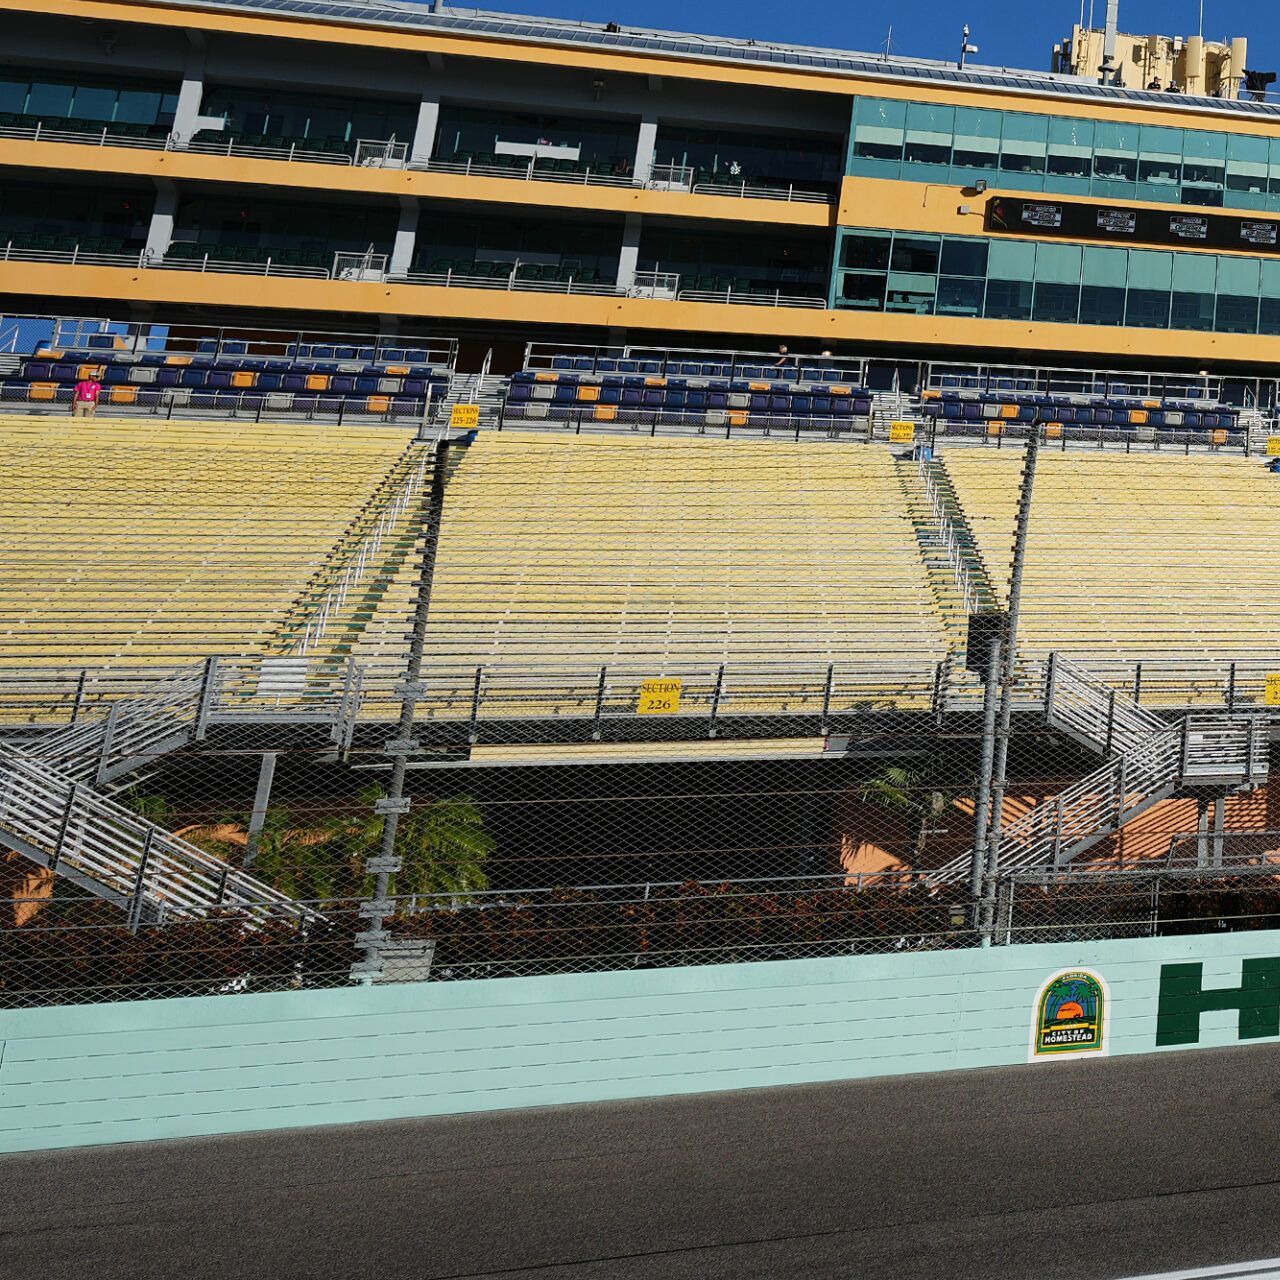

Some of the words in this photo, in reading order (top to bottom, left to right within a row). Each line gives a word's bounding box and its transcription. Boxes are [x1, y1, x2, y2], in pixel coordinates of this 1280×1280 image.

[642, 683, 680, 693] SECTION
[647, 699, 671, 710] 226
[1045, 1034, 1092, 1043] HOMESTEAD
